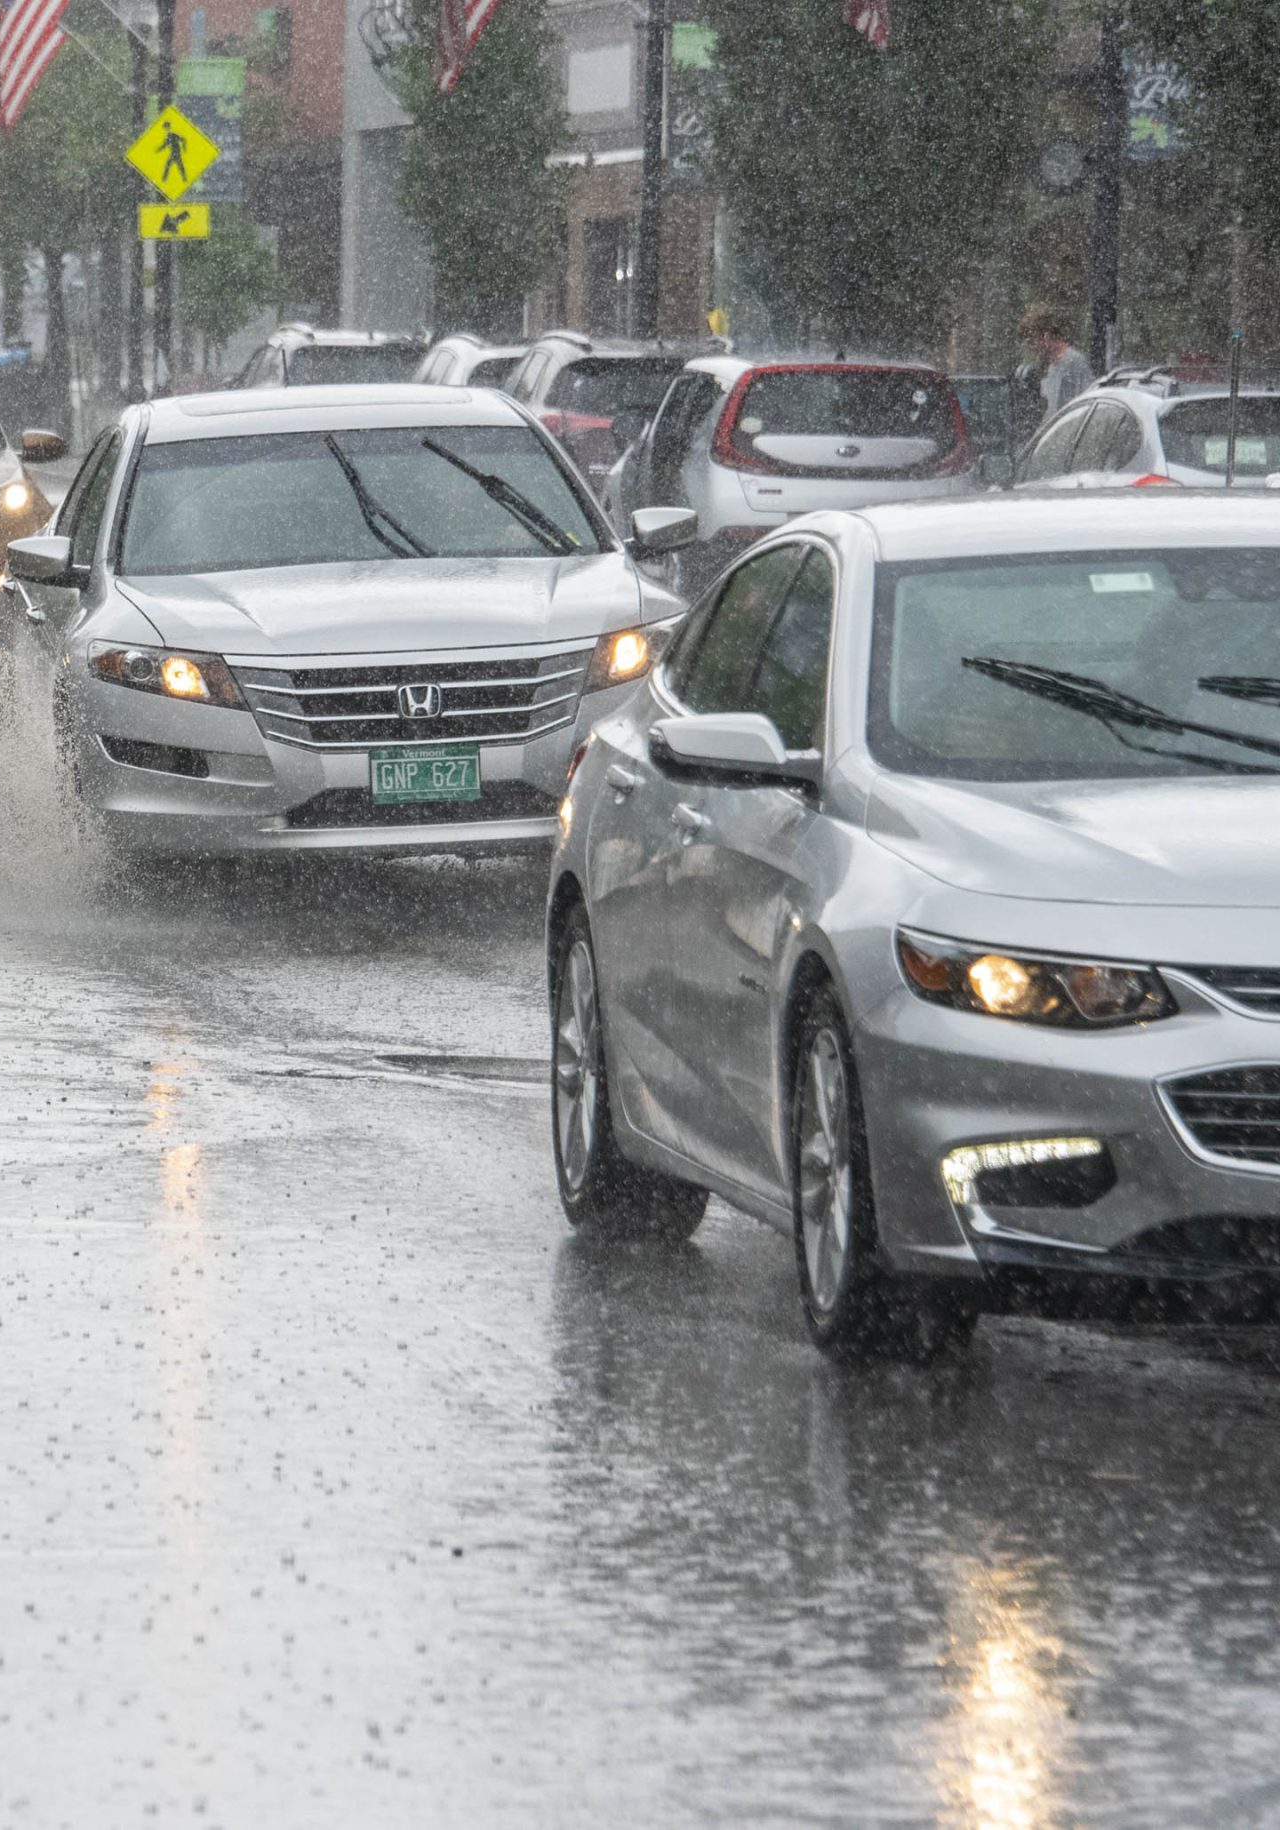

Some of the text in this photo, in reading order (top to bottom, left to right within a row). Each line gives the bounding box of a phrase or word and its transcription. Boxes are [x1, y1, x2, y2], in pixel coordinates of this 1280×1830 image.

[402, 749, 446, 758] Vermont
[381, 760, 469, 789] GNP 627
